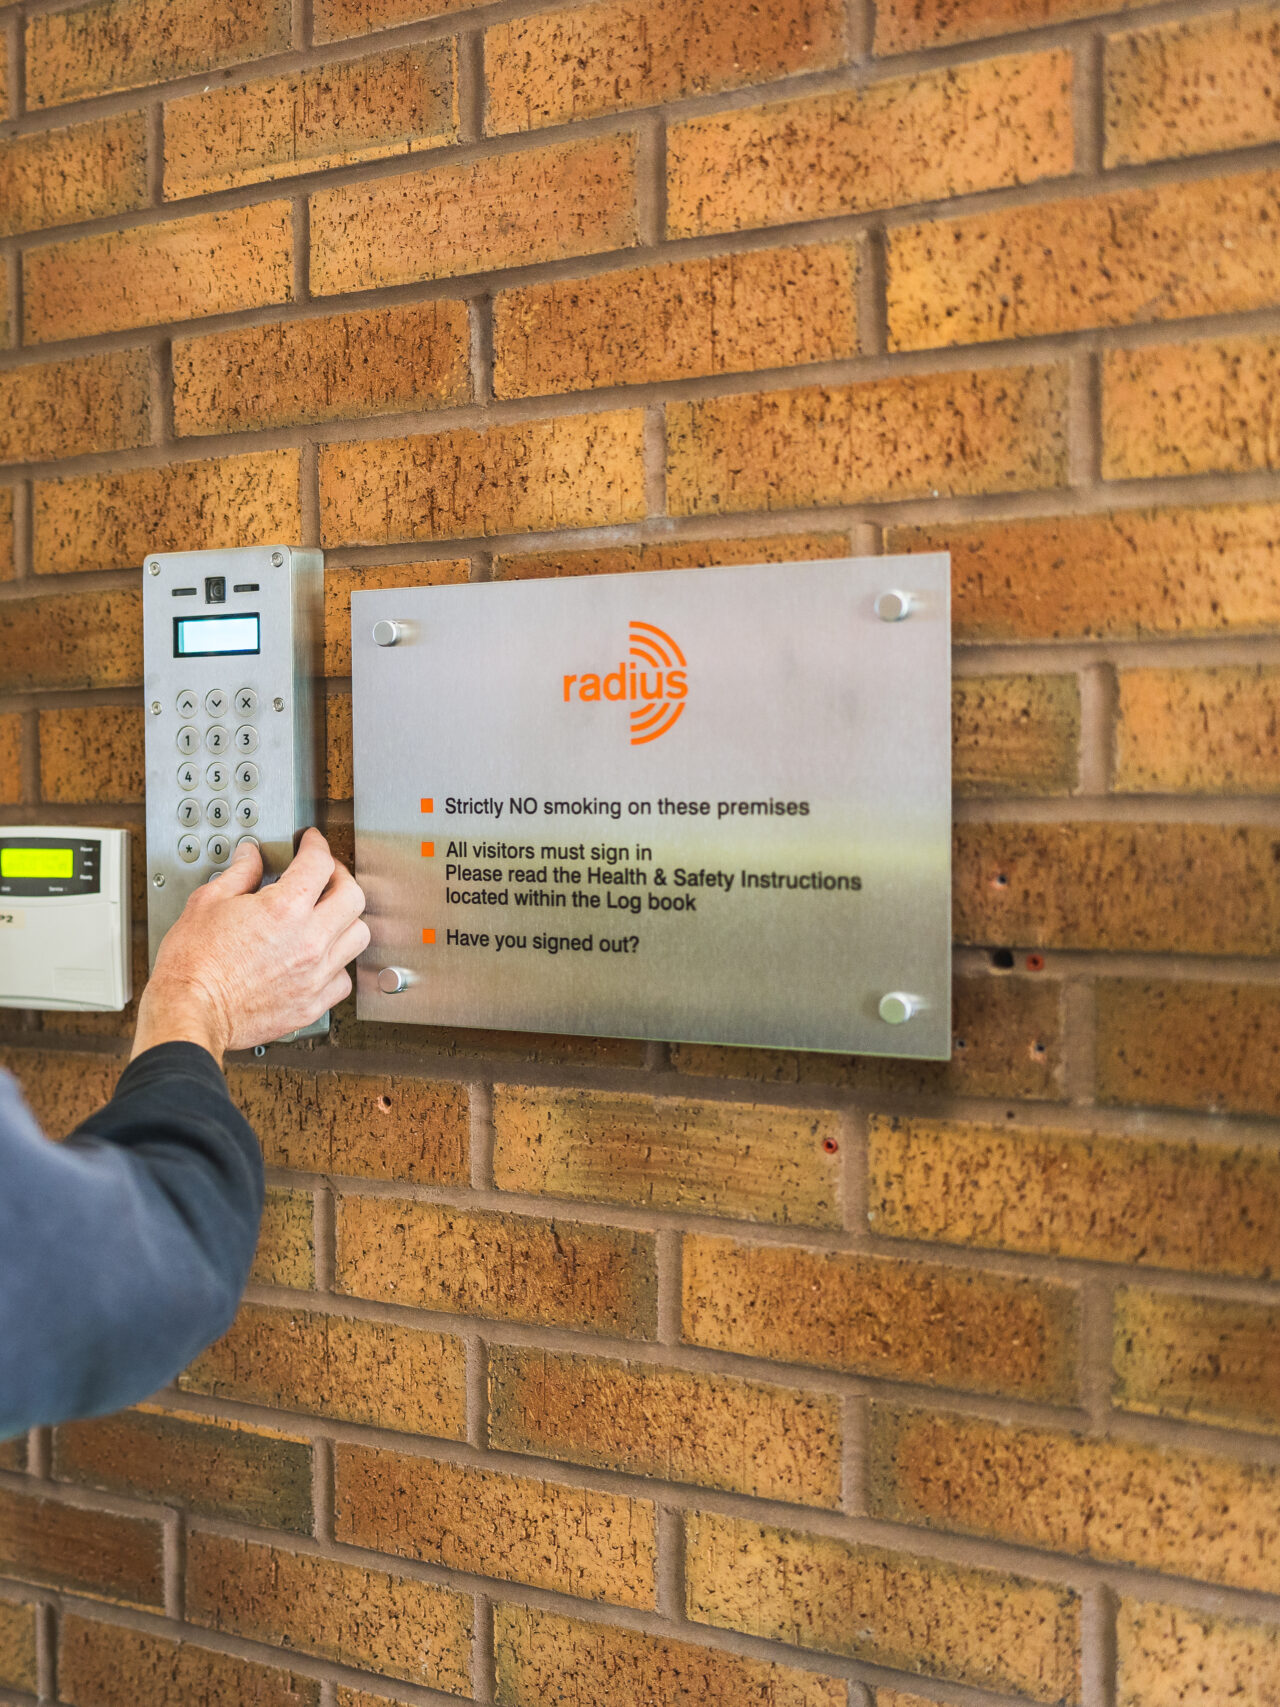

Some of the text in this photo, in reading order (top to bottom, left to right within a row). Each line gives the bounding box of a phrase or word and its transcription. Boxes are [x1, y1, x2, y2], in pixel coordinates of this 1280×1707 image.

[563, 662, 689, 702] radius
[184, 733, 251, 747] 1 2 3
[184, 770, 252, 783] 4 5 6
[185, 807, 251, 820] 7 8 9
[445, 797, 810, 820] Strictly NO smoking on these premises
[214, 843, 222, 856] 0
[446, 840, 652, 866] All visitors must sign in
[446, 863, 862, 893] Please read the Health & Safety Instructions
[446, 887, 697, 914] located within the Log book
[447, 928, 639, 955] Have you signed out?
